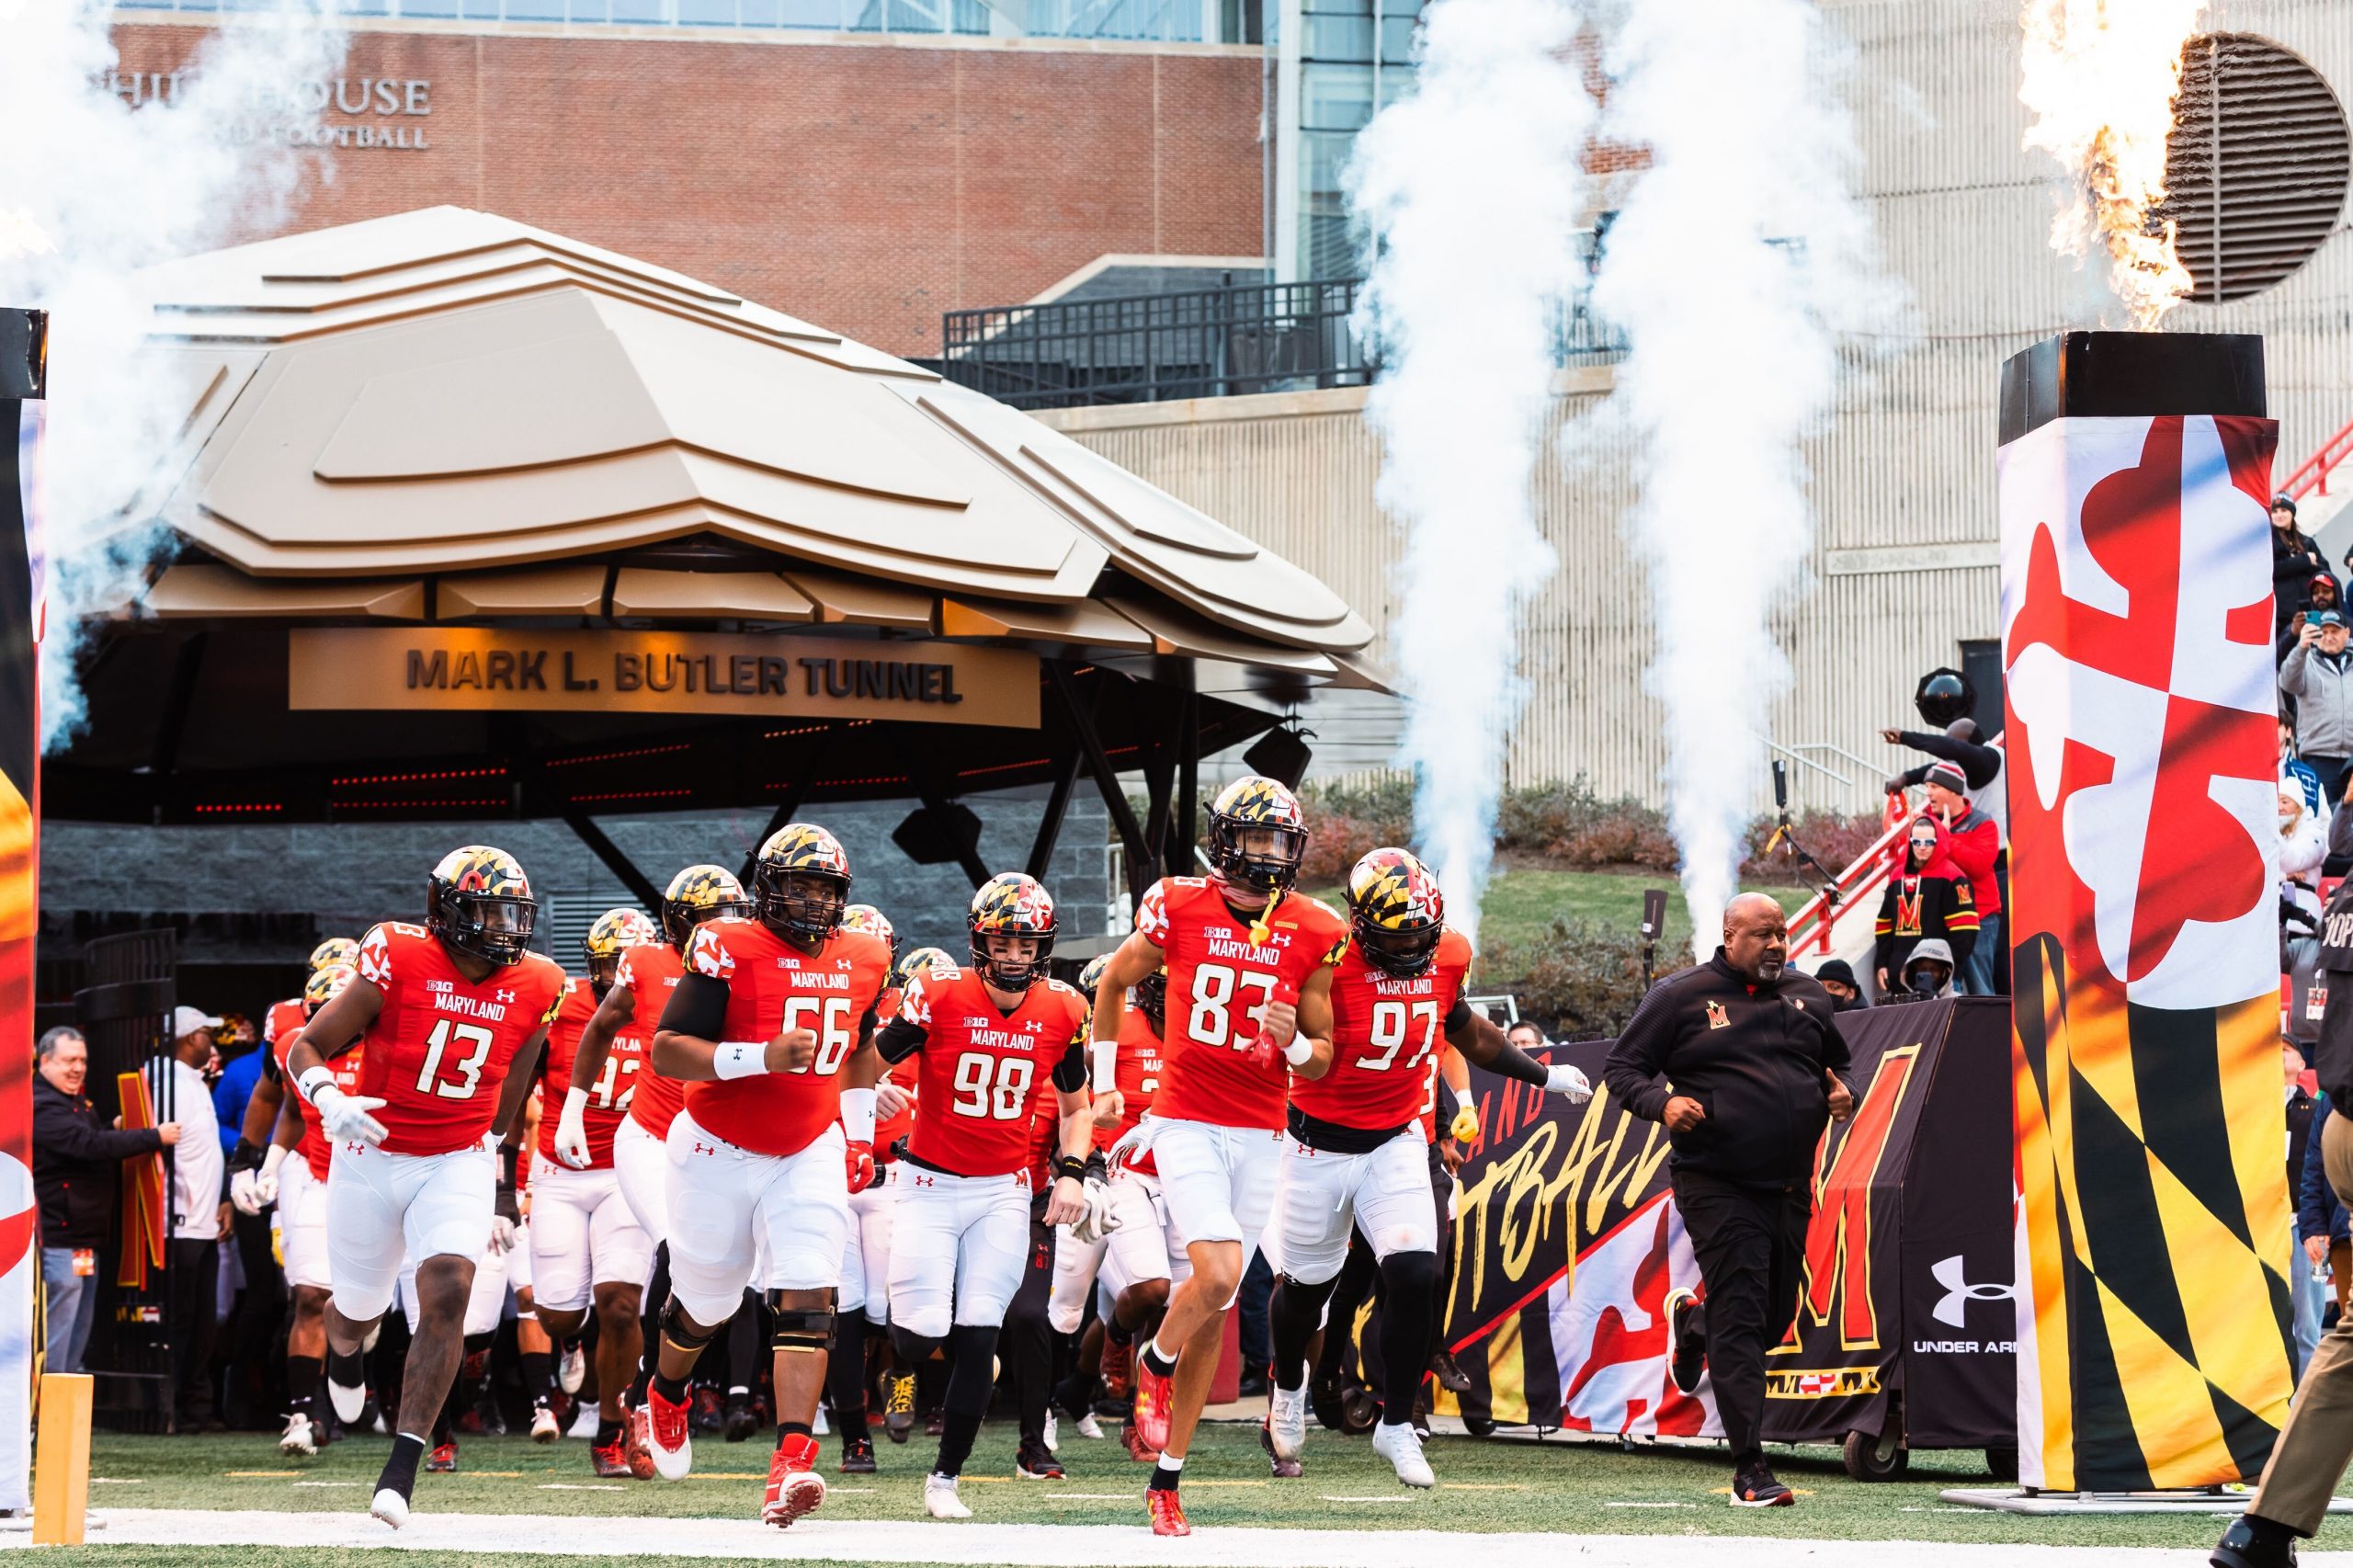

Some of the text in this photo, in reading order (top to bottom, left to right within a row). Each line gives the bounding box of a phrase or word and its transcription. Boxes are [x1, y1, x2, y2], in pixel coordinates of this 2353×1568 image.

[254, 78, 433, 116] OUSE
[406, 648, 963, 704] MARK L. BUTLER TUNNEL
[1895, 893, 1924, 932] M
[1208, 938, 1280, 966] MARYLAND
[790, 971, 849, 990] MARYLAND
[1376, 978, 1432, 995] MARYLAND
[434, 992, 506, 1022] MARYLAND
[1188, 962, 1280, 1052] 83
[1705, 1005, 1731, 1029] M
[781, 995, 852, 1076] 66
[971, 1028, 1035, 1051] MARYLAND
[1355, 1000, 1438, 1072] 97
[415, 1017, 494, 1100] 13
[952, 1051, 1035, 1120] 98
[1464, 1051, 1552, 1164] AND
[1443, 1079, 1673, 1338] TBALL
[1914, 1340, 2018, 1353] UNDER AR
